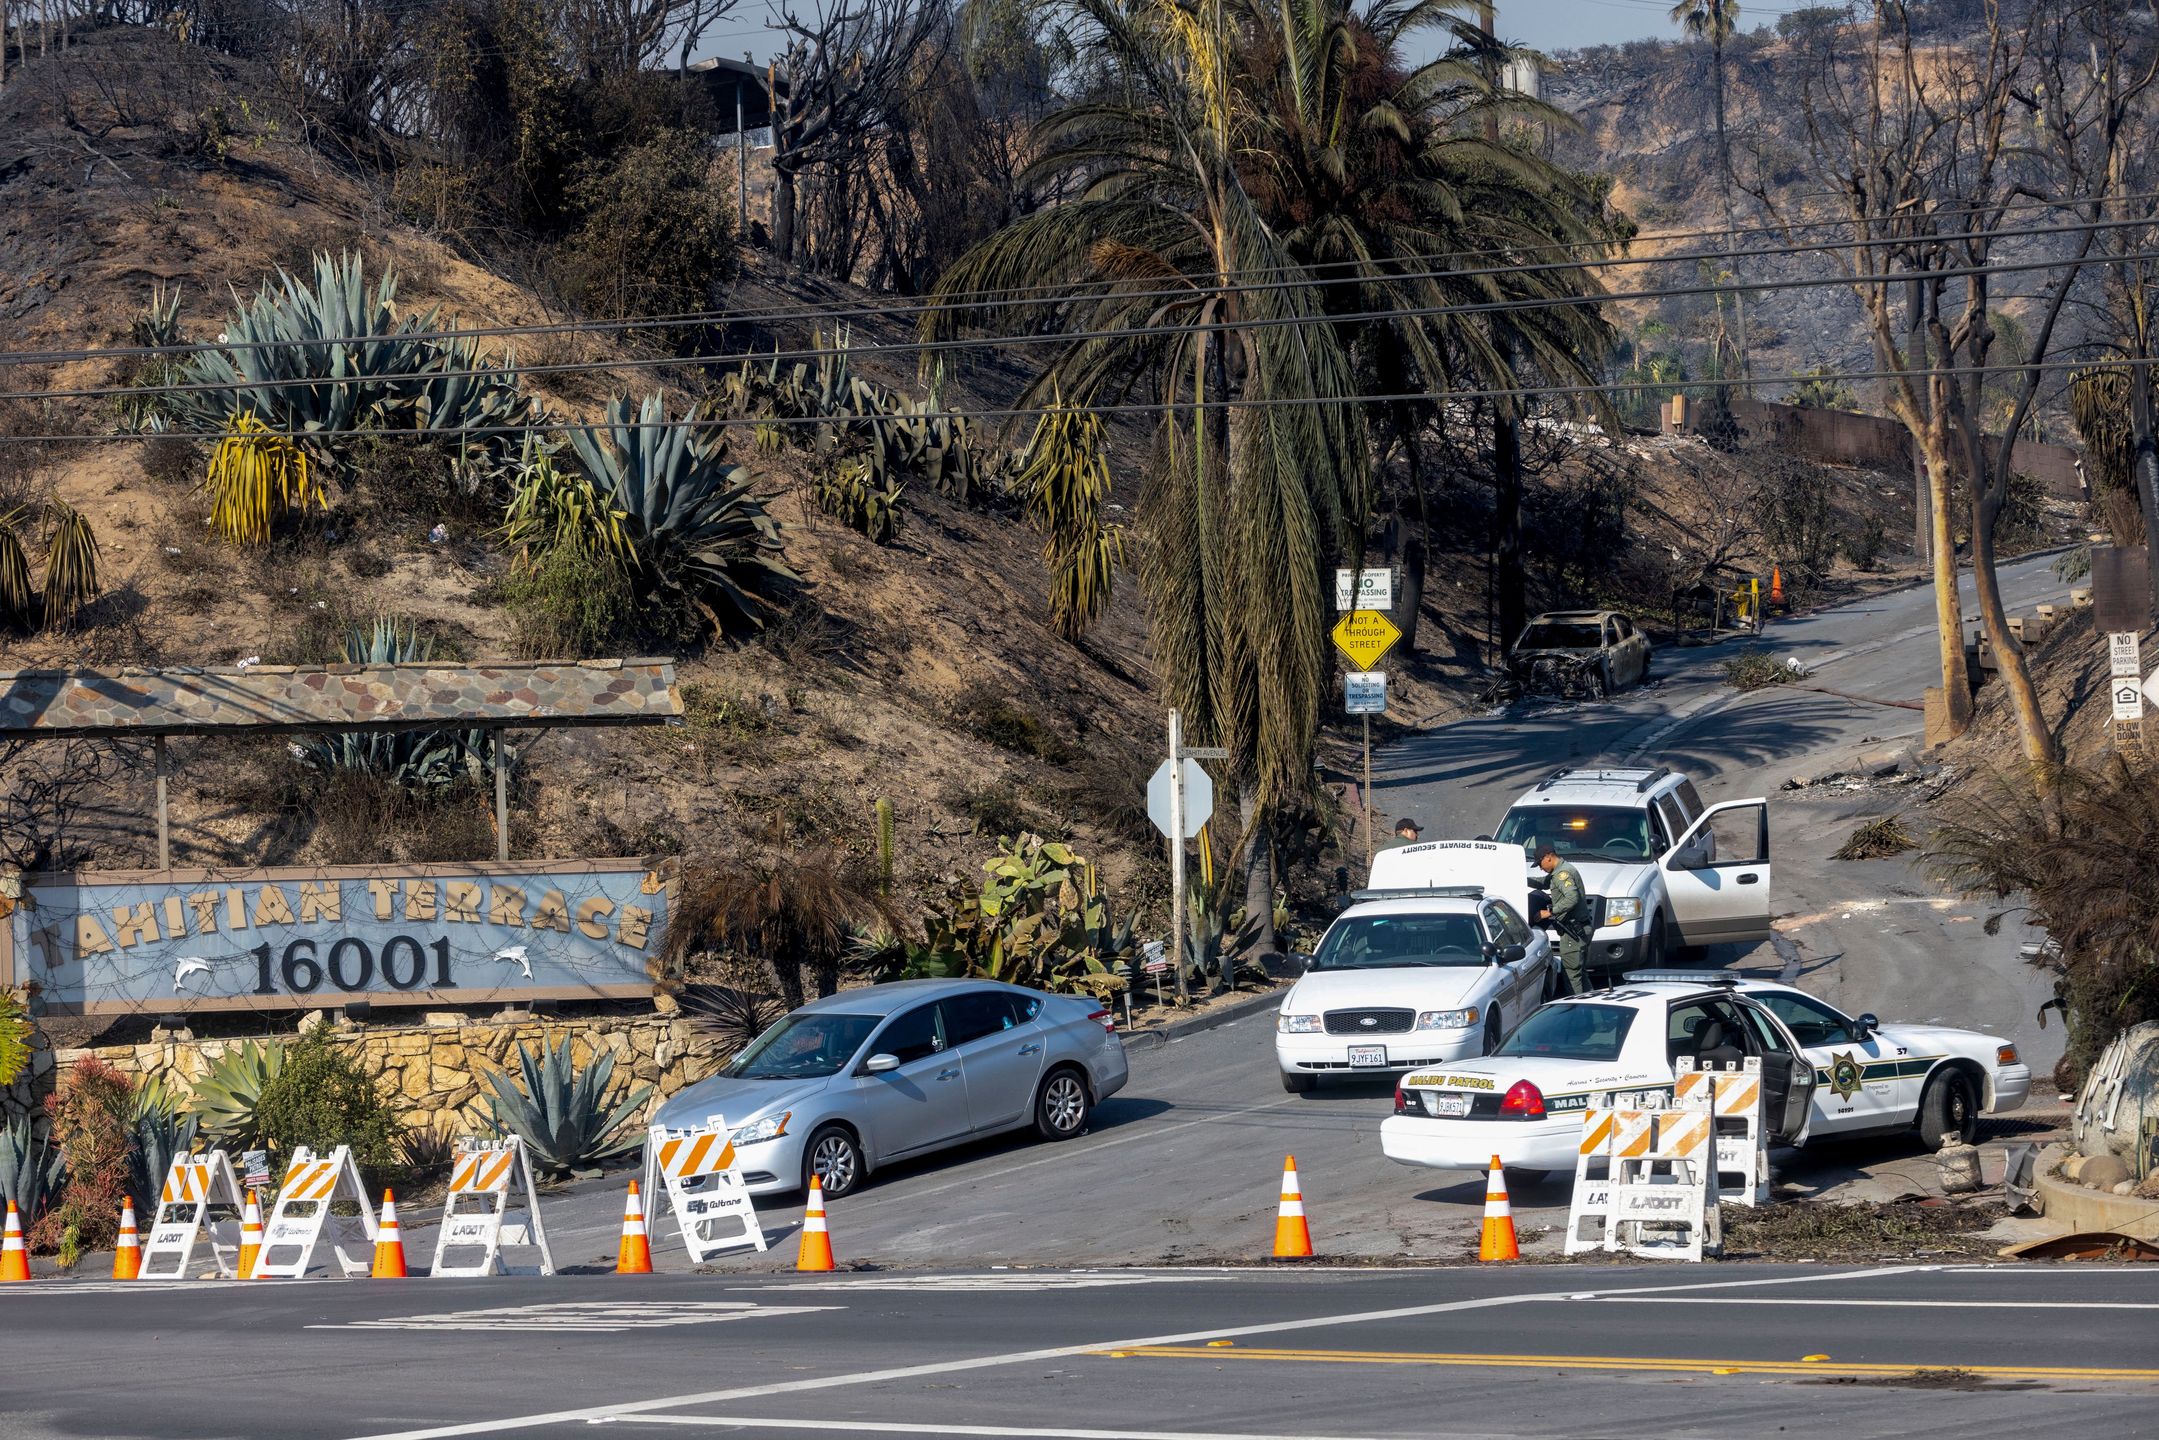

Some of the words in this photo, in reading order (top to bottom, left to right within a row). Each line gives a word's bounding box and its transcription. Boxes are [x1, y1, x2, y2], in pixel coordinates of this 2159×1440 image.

[1351, 617, 1368, 625] NOT
[1372, 617, 1379, 625] A
[1345, 628, 1386, 637] THROUGH
[1349, 640, 1381, 649] STREET
[2116, 635, 2131, 645] NO
[2113, 646, 2135, 655] STREET
[2112, 656, 2138, 665] PARKING
[2117, 722, 2140, 732] SLOW
[2117, 731, 2141, 741] DOWN
[1202, 749, 1226, 757] AVENUE
[1401, 843, 1437, 855] SECURITY
[1474, 843, 1497, 851] GATES
[368, 879, 654, 950] TERRACE
[31, 880, 343, 969] TAHITIAN
[251, 934, 458, 995] 16001
[1896, 1047, 1907, 1055] 37
[1351, 1054, 1383, 1063] 9JYF161
[1408, 1076, 1445, 1086] MALIBU
[1447, 1076, 1495, 1090] PATROL
[1594, 1076, 1618, 1084] Security
[1624, 1073, 1648, 1081] Cameras
[709, 1198, 742, 1209] Caltrans
[1629, 1196, 1684, 1210] LADOT
[452, 1224, 486, 1236] LADOT
[156, 1233, 184, 1244] LADOT
